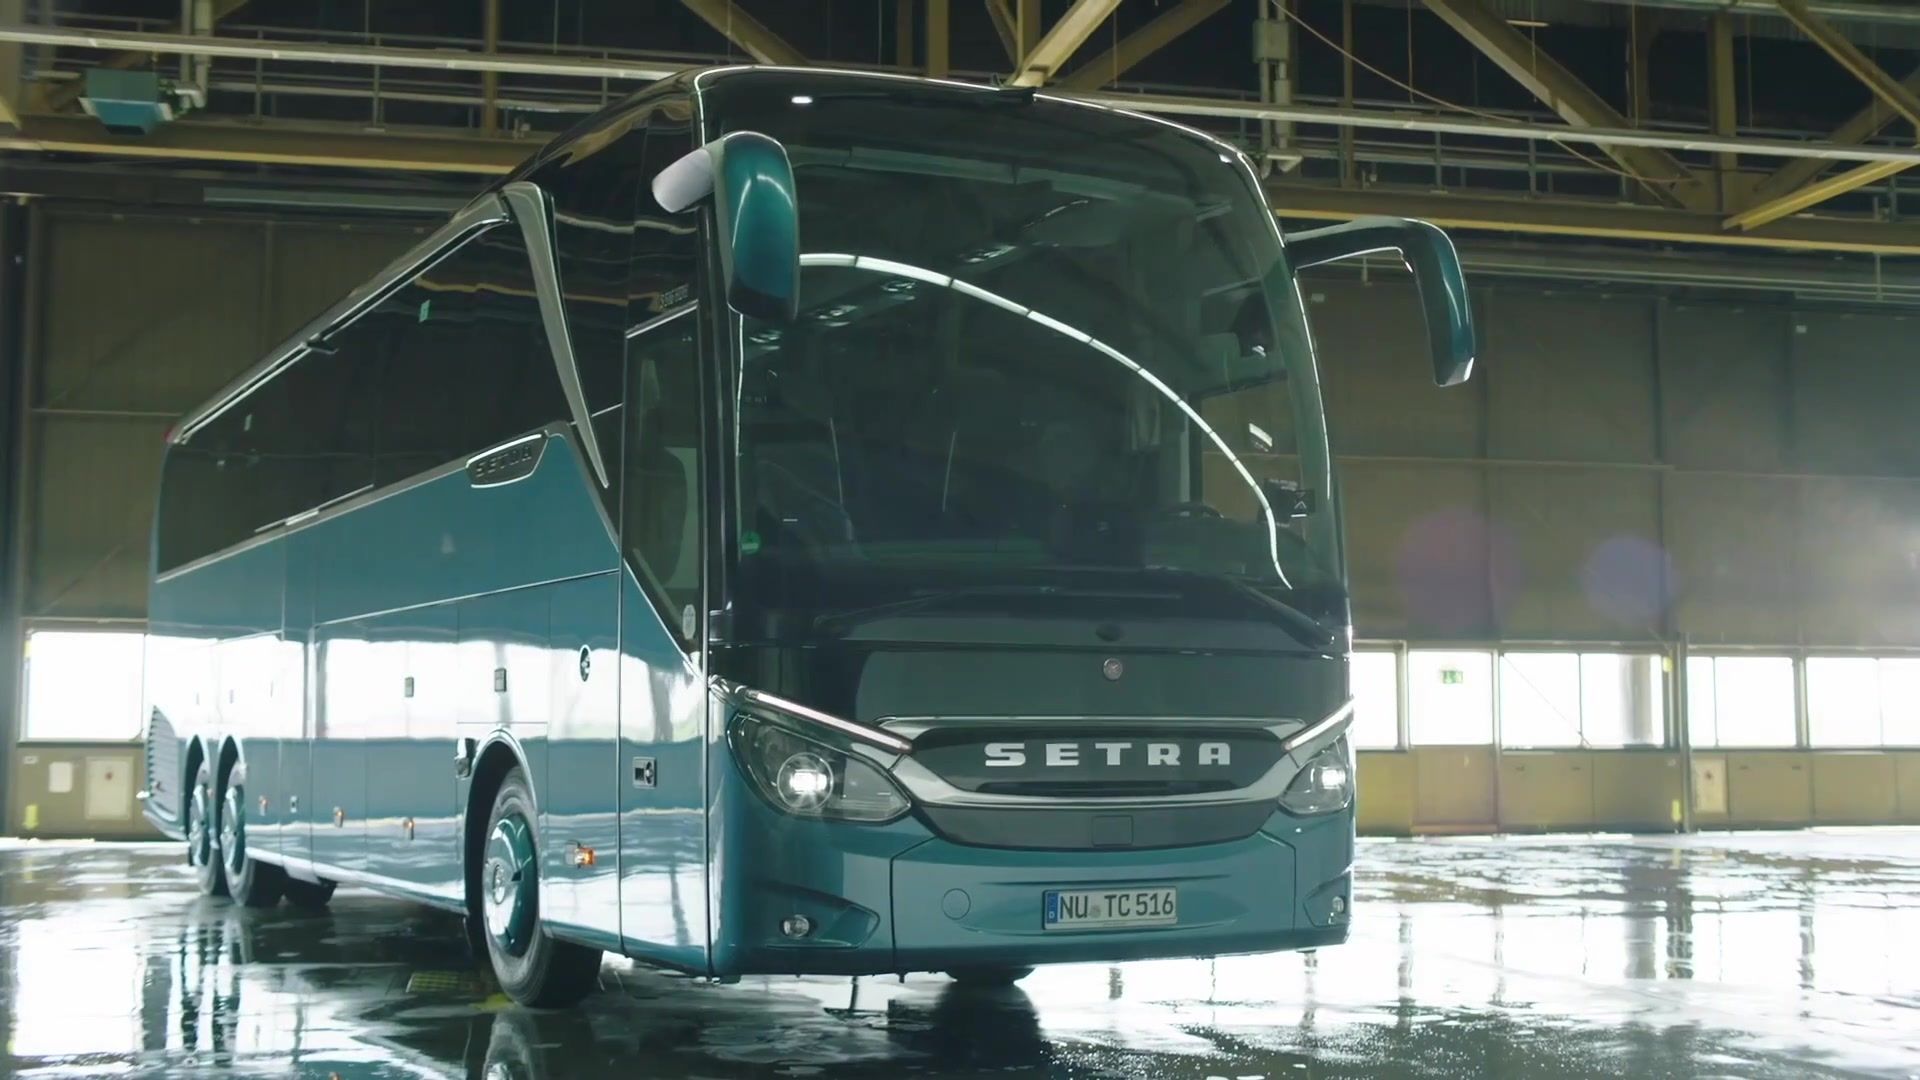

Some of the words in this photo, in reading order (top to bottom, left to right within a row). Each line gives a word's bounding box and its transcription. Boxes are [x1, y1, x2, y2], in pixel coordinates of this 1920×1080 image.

[984, 742, 1231, 767] SETRA
[1060, 895, 1089, 920] NU
[1104, 894, 1131, 918] TC
[1135, 892, 1174, 916] 516
